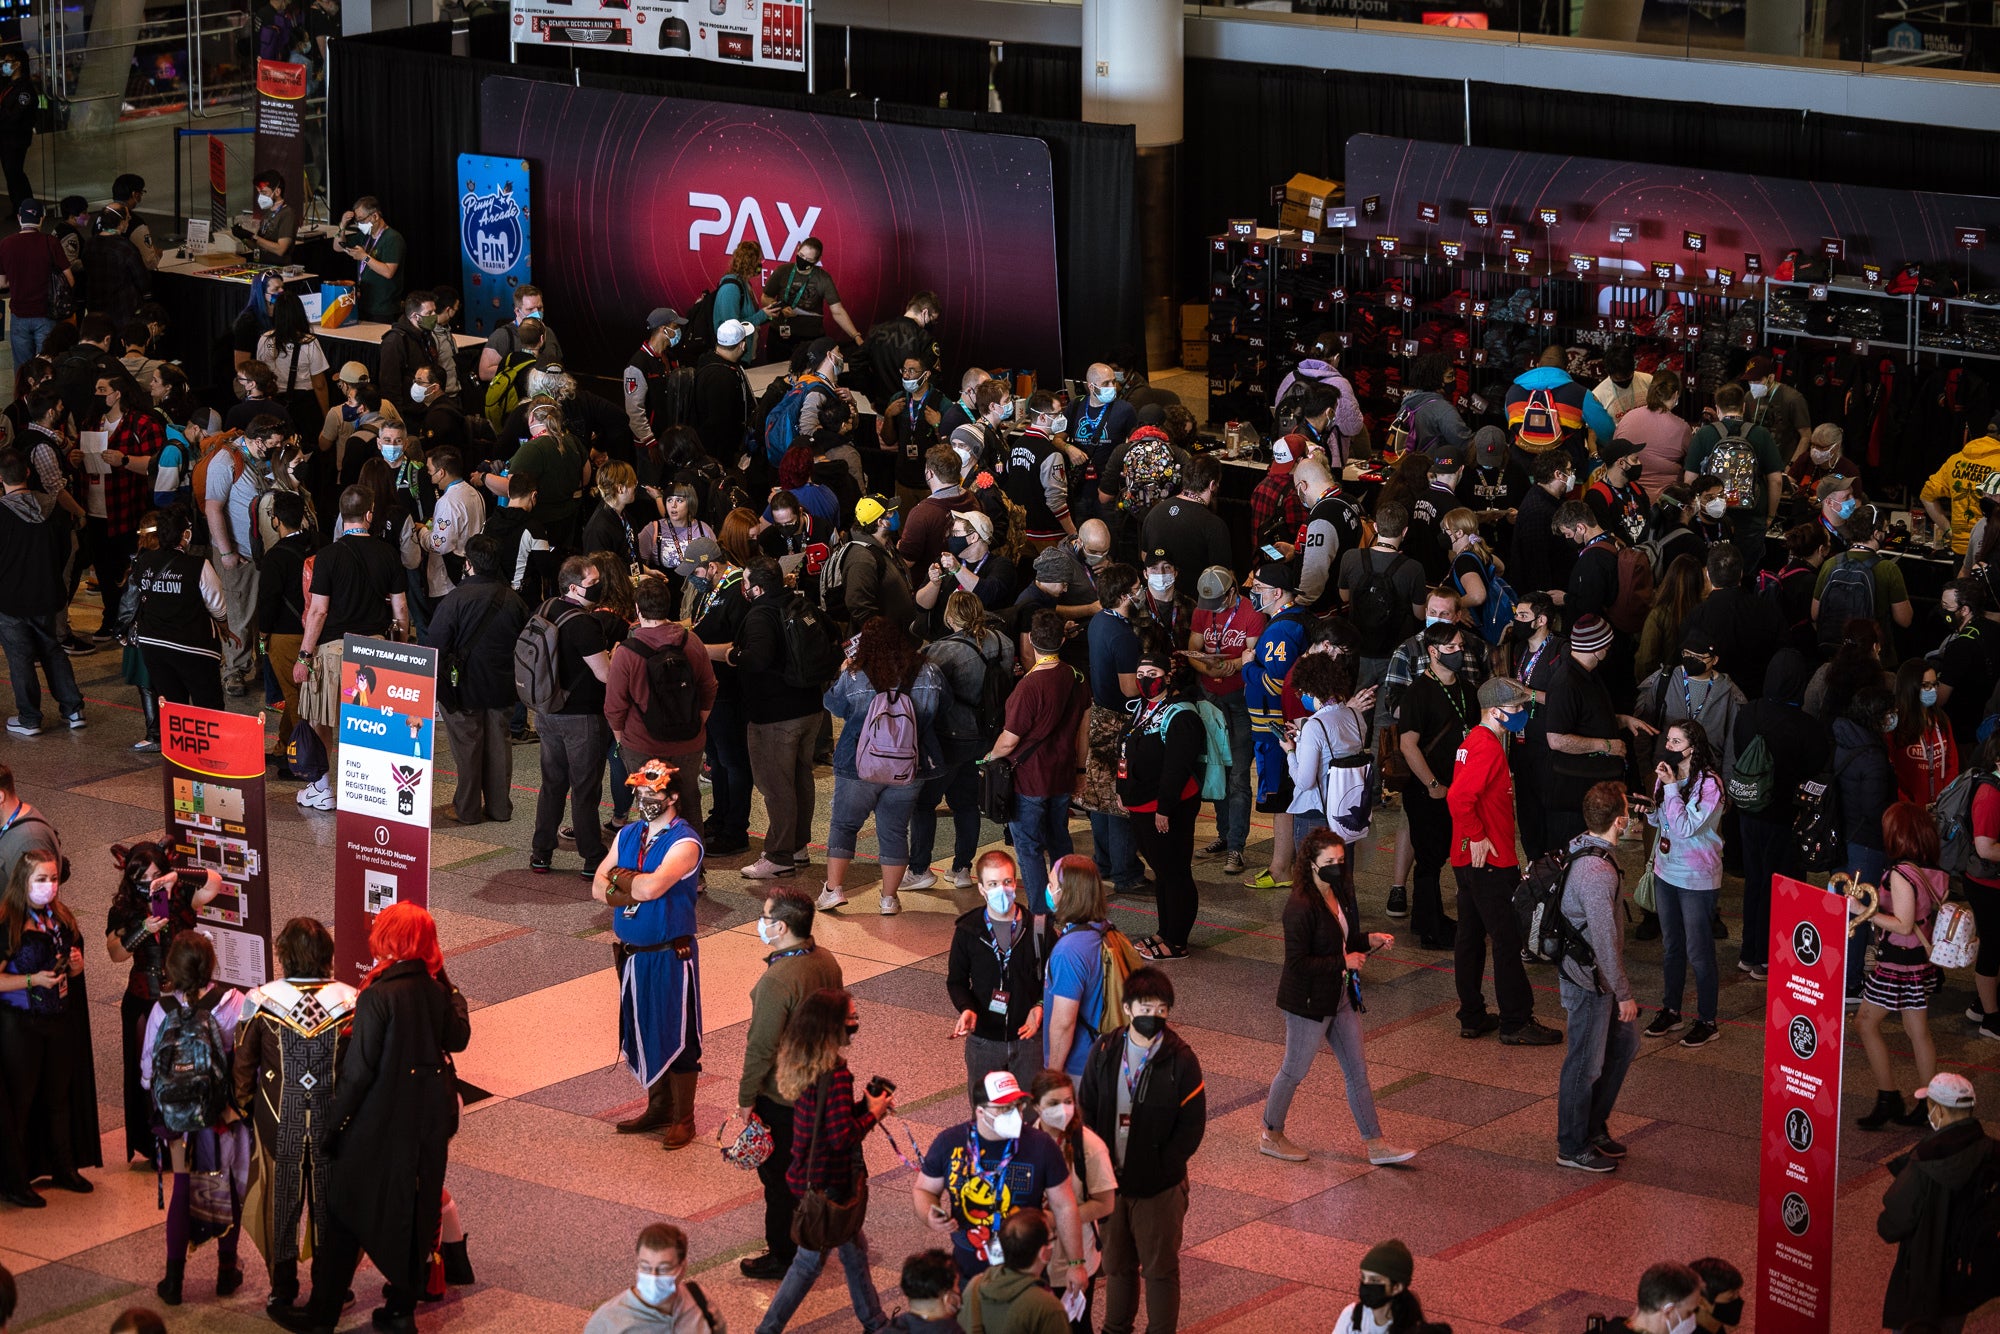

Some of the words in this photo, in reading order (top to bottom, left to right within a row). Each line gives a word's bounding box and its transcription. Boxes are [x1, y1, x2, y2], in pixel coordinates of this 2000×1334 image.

[1348, 1, 1388, 13] BOOTH
[464, 196, 495, 215] Pinny
[478, 202, 518, 227] Arcade
[1474, 214, 1488, 224] $65
[1541, 213, 1557, 223] $65
[688, 191, 823, 267] PAX
[1234, 225, 1251, 234] $50
[1214, 242, 1225, 251] XS
[1380, 240, 1395, 251] $25
[1687, 237, 1701, 249] $25
[481, 242, 505, 262] PIN
[1253, 246, 1259, 255] S
[1443, 245, 1458, 256] $25
[1301, 253, 1307, 261] S
[1515, 253, 1530, 264] $25
[482, 261, 506, 270] TRADING
[1574, 259, 1590, 270] $25
[1656, 267, 1670, 278] $25
[1866, 270, 1878, 281] $85
[1718, 273, 1731, 286] $25
[1215, 287, 1222, 297] M
[1254, 292, 1260, 301] L
[1331, 289, 1344, 299] XS
[1812, 287, 1824, 297] XS
[1281, 297, 1288, 306] M
[1318, 301, 1324, 309] L
[1390, 295, 1397, 304] S
[1403, 296, 1413, 307] XS
[1460, 302, 1466, 311] S
[1473, 302, 1485, 312] XS
[1932, 302, 1939, 311] M
[1529, 311, 1535, 320] S
[1543, 312, 1554, 322] XS
[1598, 320, 1604, 328] S
[1614, 319, 1625, 329] XS
[1672, 327, 1679, 335] S
[1687, 327, 1698, 336] XS
[1211, 333, 1221, 343] XL
[1249, 338, 1265, 347] 2XL
[1746, 335, 1752, 344] S
[1294, 343, 1305, 353] XL
[1391, 342, 1397, 351] L
[1405, 344, 1413, 352] M
[1856, 342, 1862, 350] S
[1460, 350, 1465, 359] L
[1475, 353, 1483, 362] M
[1687, 376, 1695, 384] M
[1249, 384, 1263, 393] 4XL
[1386, 386, 1400, 396] 2XL
[1457, 397, 1469, 408] 2XL
[1472, 398, 1482, 410] XL
[1306, 533, 1324, 547] 20
[152, 580, 182, 594] BELOW
[352, 645, 375, 657] WHICH
[375, 649, 394, 660] TEAM
[393, 654, 409, 663] ARE
[409, 656, 427, 666] YOU?
[1264, 641, 1287, 662] 24
[387, 684, 420, 702] GABE
[380, 704, 394, 717] VS
[169, 714, 220, 740] BCEC
[346, 716, 387, 736] TYCHO
[170, 733, 210, 754] MAP
[346, 760, 362, 769] FIND
[345, 770, 359, 778] OUT
[360, 772, 369, 781] BY
[345, 780, 387, 795] REGISTERING
[345, 791, 363, 801] YOUR
[364, 794, 388, 806] BADGE:
[378, 829, 385, 842] 1
[347, 841, 360, 851] Find
[373, 847, 393, 857] PAX-ID
[393, 851, 417, 862] Number
[361, 854, 371, 863] the
[380, 858, 391, 866] box
[390, 860, 408, 870] below.
[1791, 974, 1806, 985] WEAR
[1806, 979, 1820, 990] YOUR
[1785, 981, 1812, 996] APPROVED
[1811, 989, 1824, 1000] FACE
[1792, 991, 1817, 1007] COVERING
[1780, 1064, 1795, 1075] WASH
[1794, 1069, 1802, 1078] OR
[1802, 1072, 1823, 1086] SANITIZE
[1786, 1075, 1800, 1086] YOUR
[1799, 1080, 1817, 1092] HANDS
[1785, 1084, 1816, 1100] FREQUENTLY
[1789, 1161, 1806, 1174] SOCIAL
[1785, 1169, 1808, 1184] DISTANCE
[1775, 1241, 1785, 1250] NO
[1784, 1245, 1813, 1262] HANDSHAKE
[1775, 1249, 1792, 1261] POLICY
[1797, 1259, 1813, 1271] PLACE
[1768, 1268, 1780, 1278] TEXT
[1769, 1277, 1777, 1285] TO
[1791, 1286, 1799, 1295] TO
[1798, 1289, 1817, 1302] REPORT
[1769, 1285, 1796, 1302] SUSPICIOUS
[1796, 1297, 1817, 1310] ACTIVITY
[1769, 1294, 1777, 1302] OR
[1776, 1297, 1798, 1311] BUILDING
